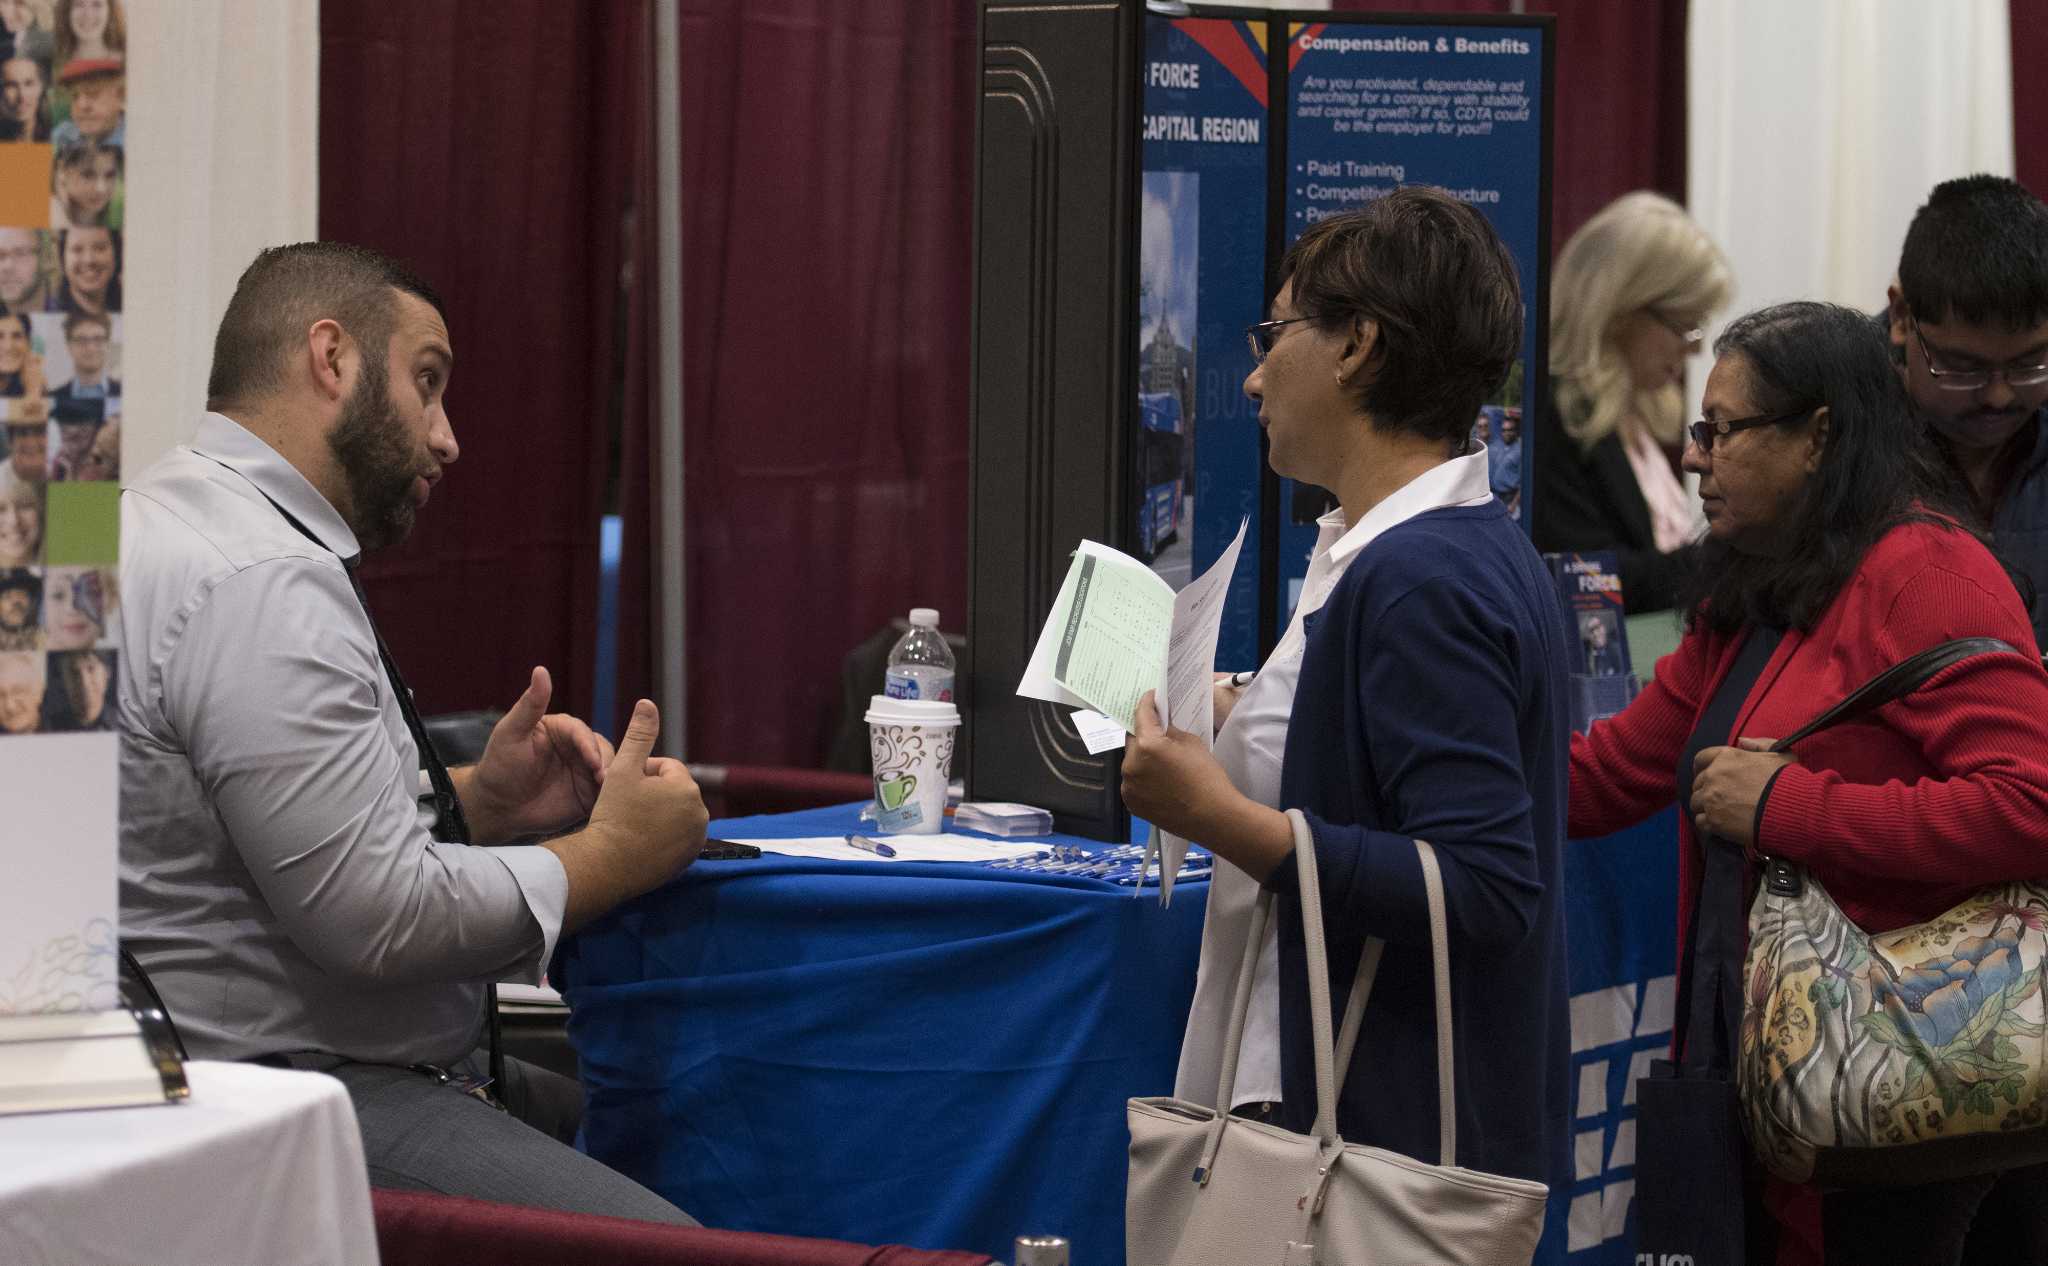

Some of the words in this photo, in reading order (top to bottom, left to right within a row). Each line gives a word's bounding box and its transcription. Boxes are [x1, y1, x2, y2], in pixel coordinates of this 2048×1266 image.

[1299, 34, 1429, 54] Compensation
[1435, 37, 1449, 53] &
[1455, 37, 1529, 54] Benefits
[1151, 62, 1199, 88] FORCE
[1303, 76, 1327, 89] Are
[1329, 79, 1353, 92] you
[1355, 78, 1419, 91] motivated,
[1423, 79, 1496, 93] dependable
[1499, 80, 1524, 92] and
[1298, 91, 1359, 106] searching
[1361, 91, 1379, 104] for
[1382, 94, 1391, 104] a
[1393, 95, 1451, 108] company
[1454, 94, 1479, 105] with
[1481, 94, 1529, 109] stability
[1297, 104, 1322, 117] and
[1324, 107, 1365, 118] career
[1367, 106, 1419, 121] growth?
[1455, 106, 1492, 120] CDTA
[1494, 108, 1529, 121] could
[1202, 117, 1259, 143] REGION
[1333, 120, 1351, 132] be
[1352, 119, 1374, 132] the
[1375, 121, 1434, 136] employer
[1437, 121, 1456, 134] for
[1307, 161, 1340, 177] Paid
[1344, 161, 1405, 181] Training
